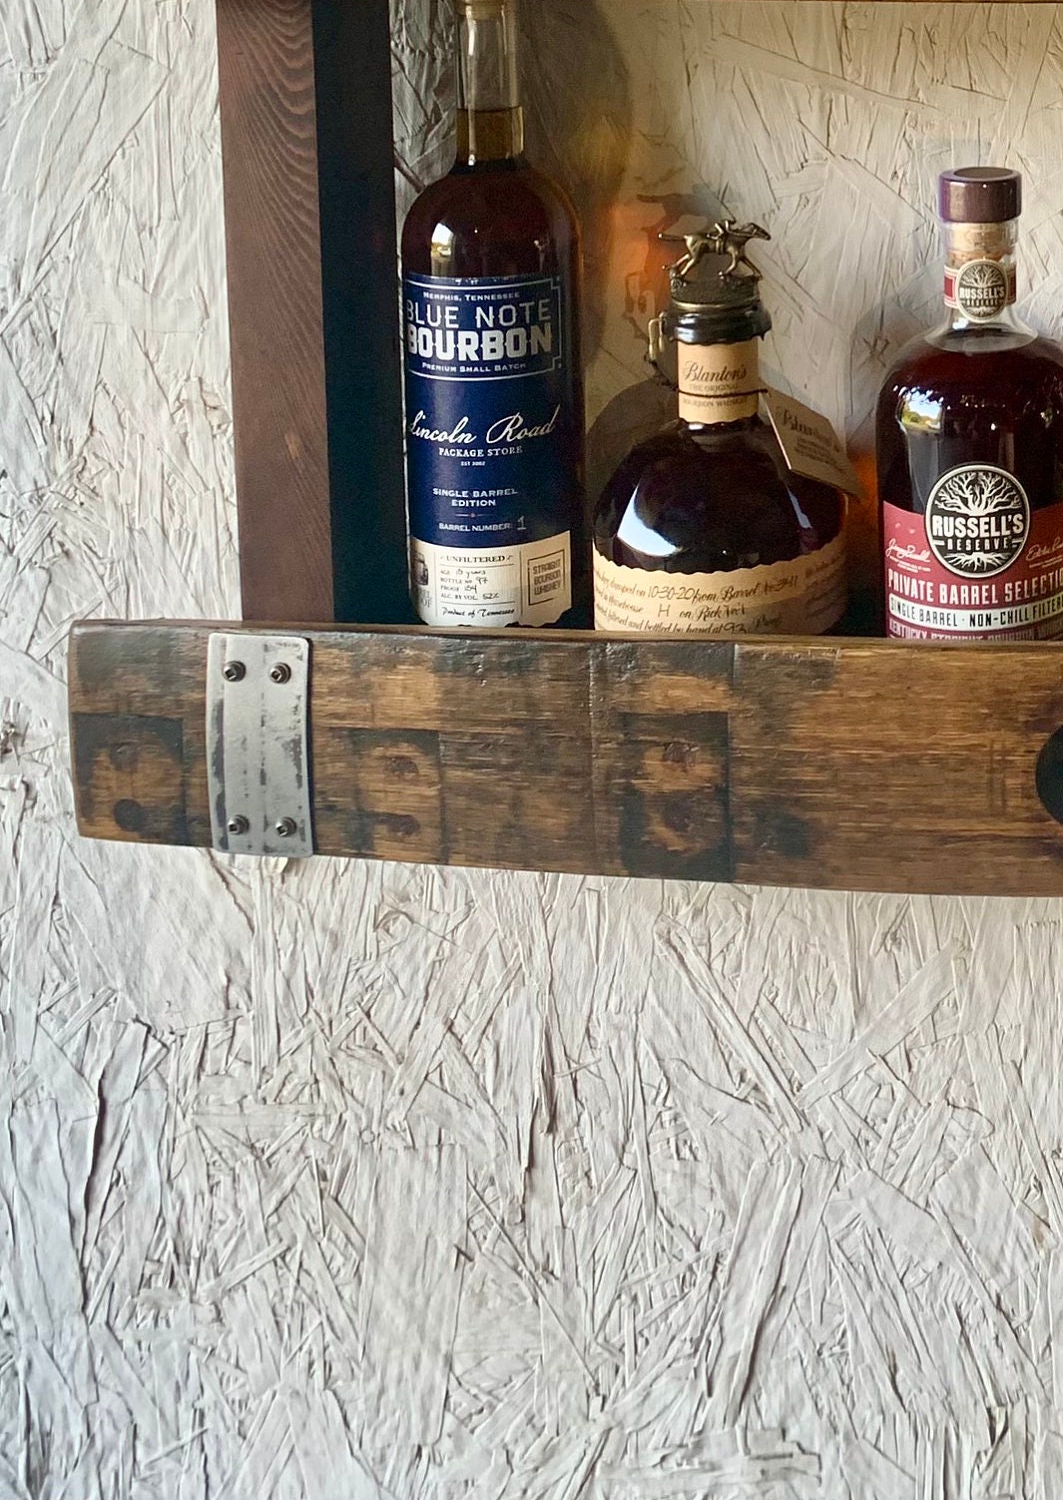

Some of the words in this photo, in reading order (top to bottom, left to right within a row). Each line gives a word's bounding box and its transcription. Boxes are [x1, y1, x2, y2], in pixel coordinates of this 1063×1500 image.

[423, 291, 462, 301] MEMPHIS,
[465, 292, 520, 301] TENNESSEE
[959, 286, 1005, 300] RUSSELL'S
[406, 300, 460, 329] BLUE
[475, 299, 551, 328] NOTE
[407, 323, 552, 361] BOURBON
[422, 362, 456, 372] PREMIUM
[460, 364, 491, 373] SMALL
[494, 363, 526, 371] BATCH
[684, 359, 748, 382] Blanton's
[409, 409, 477, 444] Lincoln
[485, 403, 561, 444] Road
[438, 447, 485, 457] PACKAGE
[487, 446, 523, 457] STORE
[432, 487, 469, 498] SINGLE
[472, 488, 518, 498] BARREL
[451, 499, 497, 507] EDITION
[439, 523, 471, 531] BARREL
[931, 514, 1024, 539] RUSSELL'S
[947, 537, 1009, 551] RESERVE
[446, 555, 506, 563] UNFILTERED
[533, 569, 561, 585] BOURBON
[888, 568, 934, 602] PRIVATE
[939, 583, 998, 605] BARREL
[657, 603, 671, 618] H
[890, 595, 916, 621] SINGLE
[919, 608, 958, 628] BARREL
[969, 608, 1030, 628] NON-CHILL
